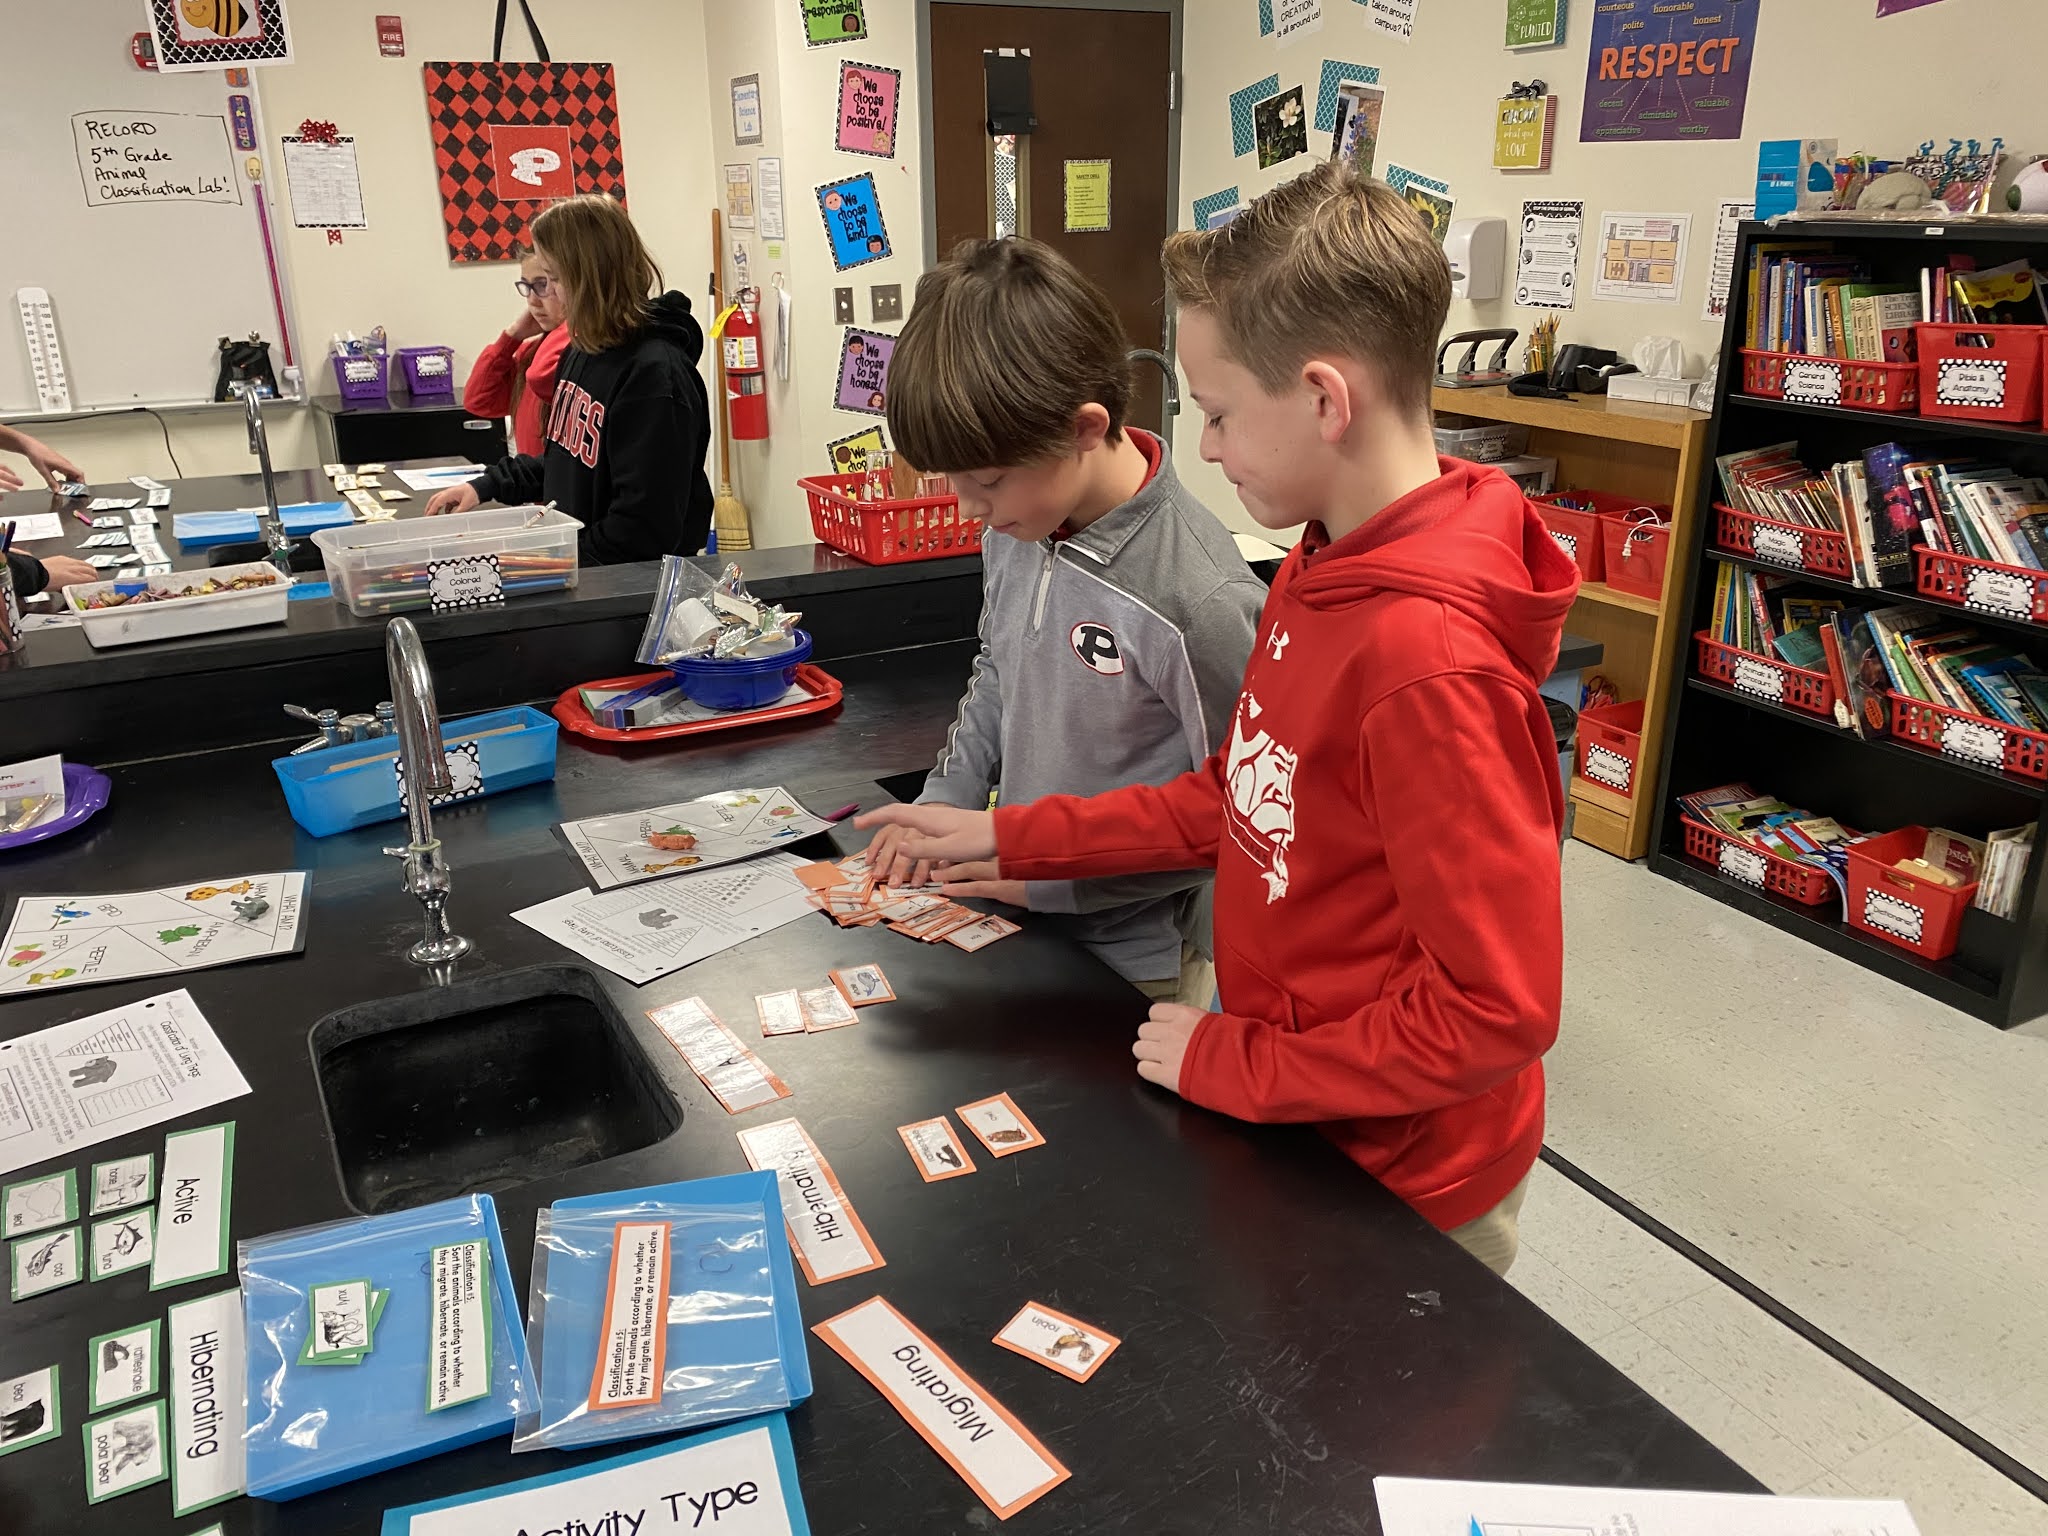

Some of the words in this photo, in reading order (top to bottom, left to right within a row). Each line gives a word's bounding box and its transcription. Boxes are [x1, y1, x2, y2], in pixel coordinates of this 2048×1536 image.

[806, 2, 858, 18] responsible!
[1280, 0, 1314, 22] CREATION
[1372, 0, 1388, 13] taken
[1389, 8, 1411, 21] around
[1598, 2, 1635, 12] courteous
[1653, 2, 1694, 14] honorable
[1276, 30, 1282, 39] is
[1290, 17, 1311, 32] around
[1311, 8, 1322, 21] us!
[1374, 17, 1402, 32] campus?
[1622, 21, 1645, 31] polite
[1693, 15, 1721, 25] honest
[382, 33, 401, 42] FIRE
[1520, 22, 1552, 39] PLANTED
[1599, 37, 1740, 80] RESPECT
[862, 76, 877, 94] We
[853, 88, 884, 107] choose
[1599, 99, 1624, 108] decent
[1694, 98, 1730, 107] valuable
[856, 102, 865, 116] to
[868, 103, 879, 118] be
[1638, 110, 1678, 120] admirable
[85, 120, 157, 139] RECORD
[846, 115, 887, 131] positive!
[1595, 126, 1641, 136] appreciative
[1679, 125, 1709, 135] worthy
[91, 147, 118, 164] 5th
[124, 147, 172, 162] Grade
[1505, 142, 1527, 157] LOVE
[95, 167, 147, 181] Animal
[100, 180, 195, 199] Classification
[199, 176, 230, 194] Lab!
[840, 192, 858, 207] We
[837, 203, 867, 222] choose
[843, 220, 854, 232] to
[856, 216, 867, 229] be
[1831, 314, 1844, 341] SCIENCE
[865, 342, 879, 358] We
[855, 354, 885, 370] choose
[856, 365, 867, 378] to
[868, 367, 879, 381] be
[1799, 371, 1826, 380] General
[850, 375, 884, 392] honest!
[1799, 381, 1825, 391] Science
[1953, 384, 1989, 394] Anatomy
[850, 446, 866, 460] We
[454, 566, 477, 576] Extra
[449, 575, 481, 587] Colored
[454, 586, 482, 596] Pencils
[1077, 624, 1120, 669] P
[585, 855, 603, 871] WHAT
[285, 894, 298, 914] WHAT
[81, 945, 107, 974] REPTILE
[158, 1018, 184, 1048] Classification
[176, 1048, 195, 1067] Living
[108, 1167, 120, 1185] horse
[172, 1178, 201, 1225] Active
[101, 1253, 113, 1271] tuna
[437, 1249, 449, 1266] they
[451, 1247, 462, 1262] Sort
[634, 1241, 645, 1275] whether
[53, 1262, 65, 1278] cod
[452, 1264, 462, 1276] the
[465, 1244, 476, 1292] Classification
[645, 1255, 656, 1283] remain
[633, 1276, 642, 1285] to
[452, 1278, 463, 1307] animals
[647, 1285, 654, 1294] or
[630, 1286, 644, 1326] according
[450, 1308, 464, 1345] according
[1031, 1314, 1061, 1334] robin
[440, 1341, 447, 1350] or
[453, 1347, 462, 1355] to
[626, 1327, 638, 1360] animals
[132, 1346, 144, 1393] rattlesnake
[440, 1351, 449, 1377] remain
[452, 1356, 464, 1388] whether
[607, 1342, 623, 1398] Classification
[624, 1362, 635, 1377] the
[13, 1382, 26, 1402] bear
[622, 1378, 634, 1396] Sort
[636, 1375, 650, 1395] they
[892, 1344, 994, 1443] Migrating
[186, 1330, 224, 1459] Hibernating
[95, 1434, 108, 1461] polar
[98, 1461, 110, 1486] bear
[512, 1508, 647, 1536] ctivity
[661, 1481, 759, 1529] Type
